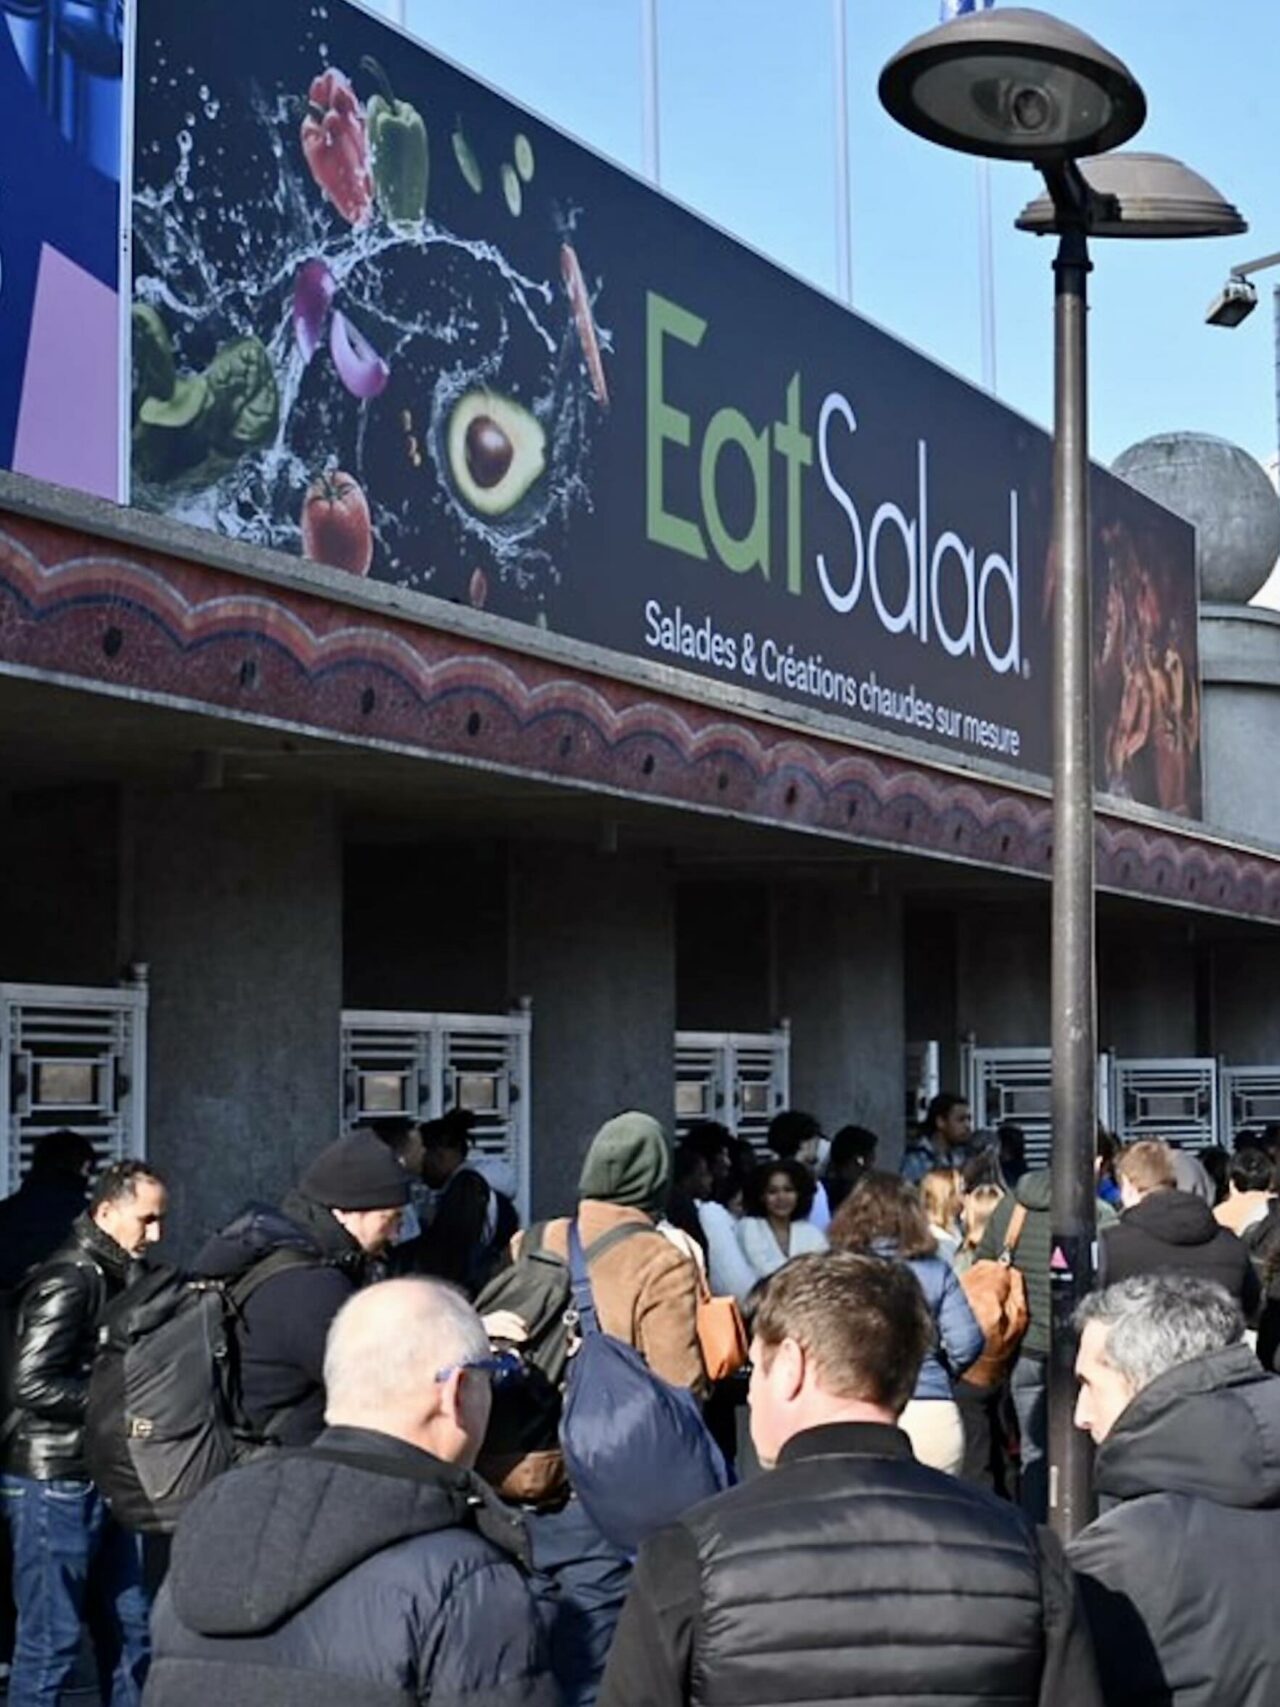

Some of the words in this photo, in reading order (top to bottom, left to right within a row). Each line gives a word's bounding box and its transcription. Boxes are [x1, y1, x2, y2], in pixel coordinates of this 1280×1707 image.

[645, 600, 737, 670] Salades
[741, 633, 758, 676] &
[761, 640, 857, 706] Créations
[859, 671, 935, 731] chaudes
[935, 703, 963, 736] sur
[963, 713, 1020, 757] mesure
